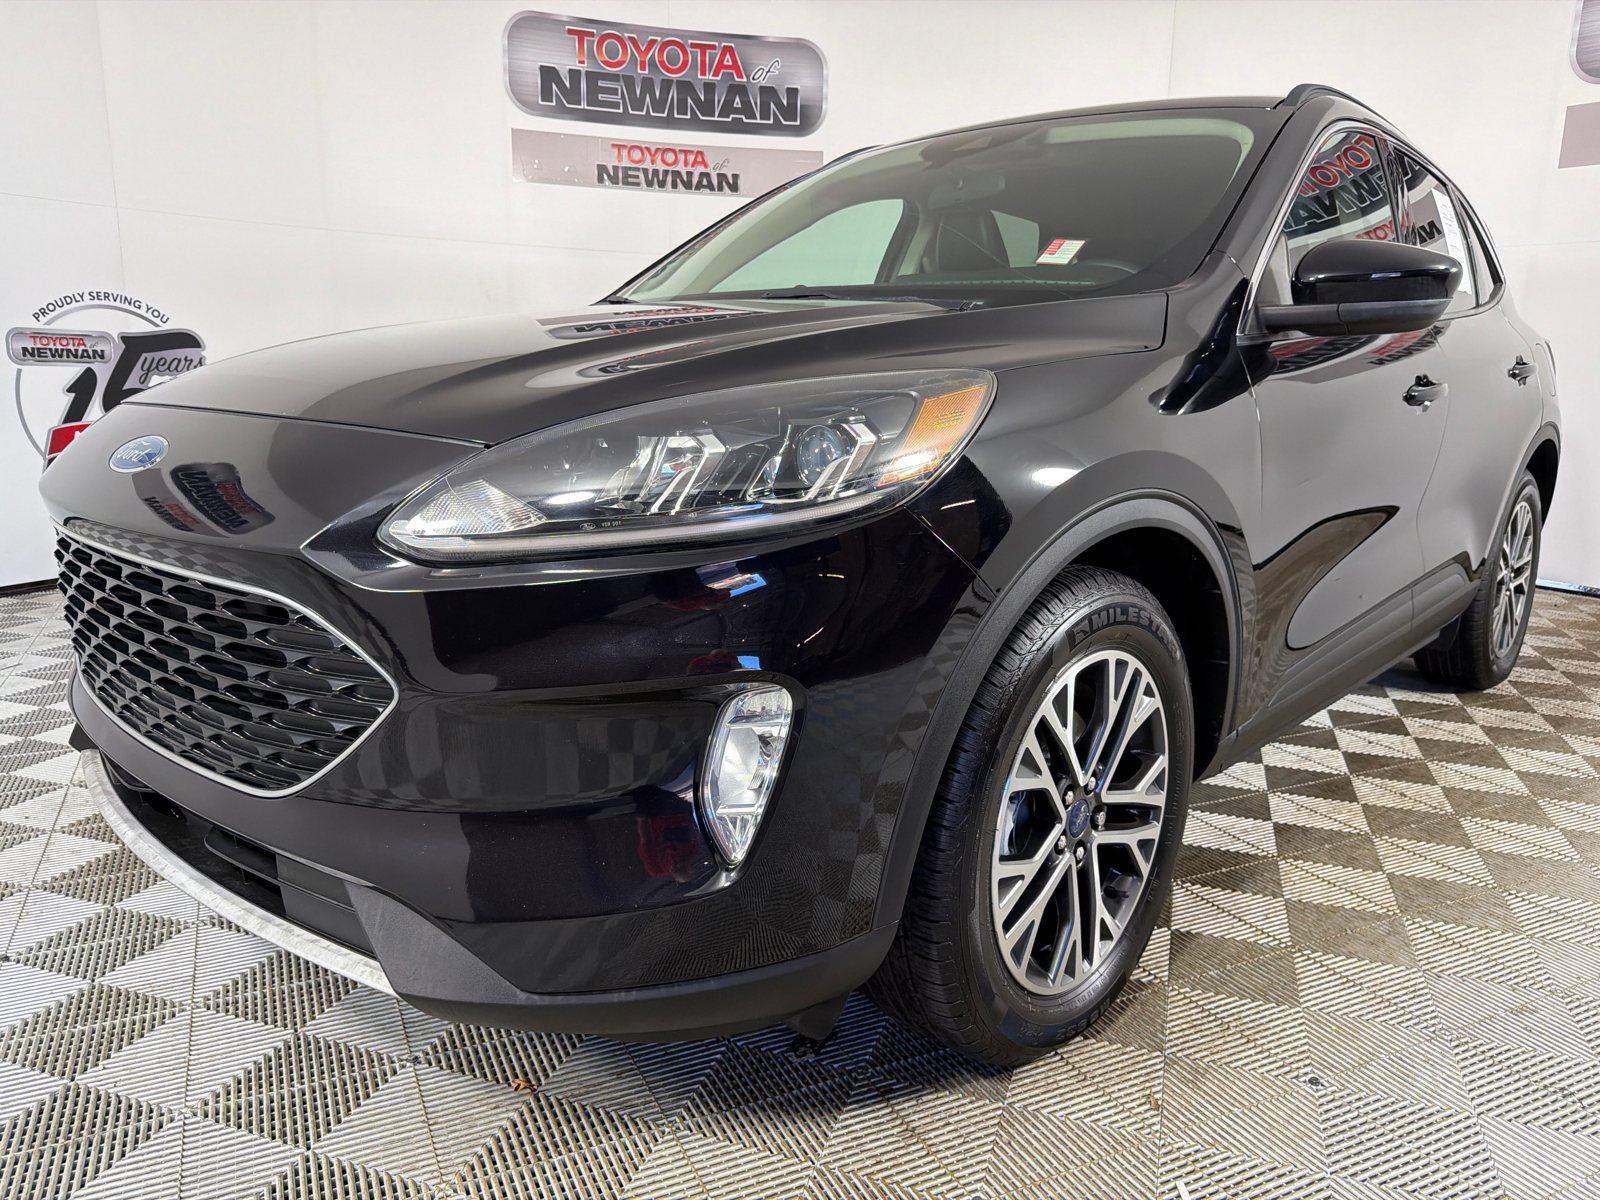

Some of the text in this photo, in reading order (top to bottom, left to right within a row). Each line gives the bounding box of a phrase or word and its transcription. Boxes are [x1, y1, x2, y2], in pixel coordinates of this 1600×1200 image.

[566, 27, 780, 83] TOYOTA of
[538, 64, 801, 125] NEWNAN
[611, 143, 730, 171] TOYOTA of
[596, 163, 740, 194] NEWNAN
[32, 291, 170, 324] PROUDLY SERVING YOU
[21, 346, 105, 360] NEWNAN
[29, 335, 87, 348] TOYOTA
[116, 440, 152, 463] Ford
